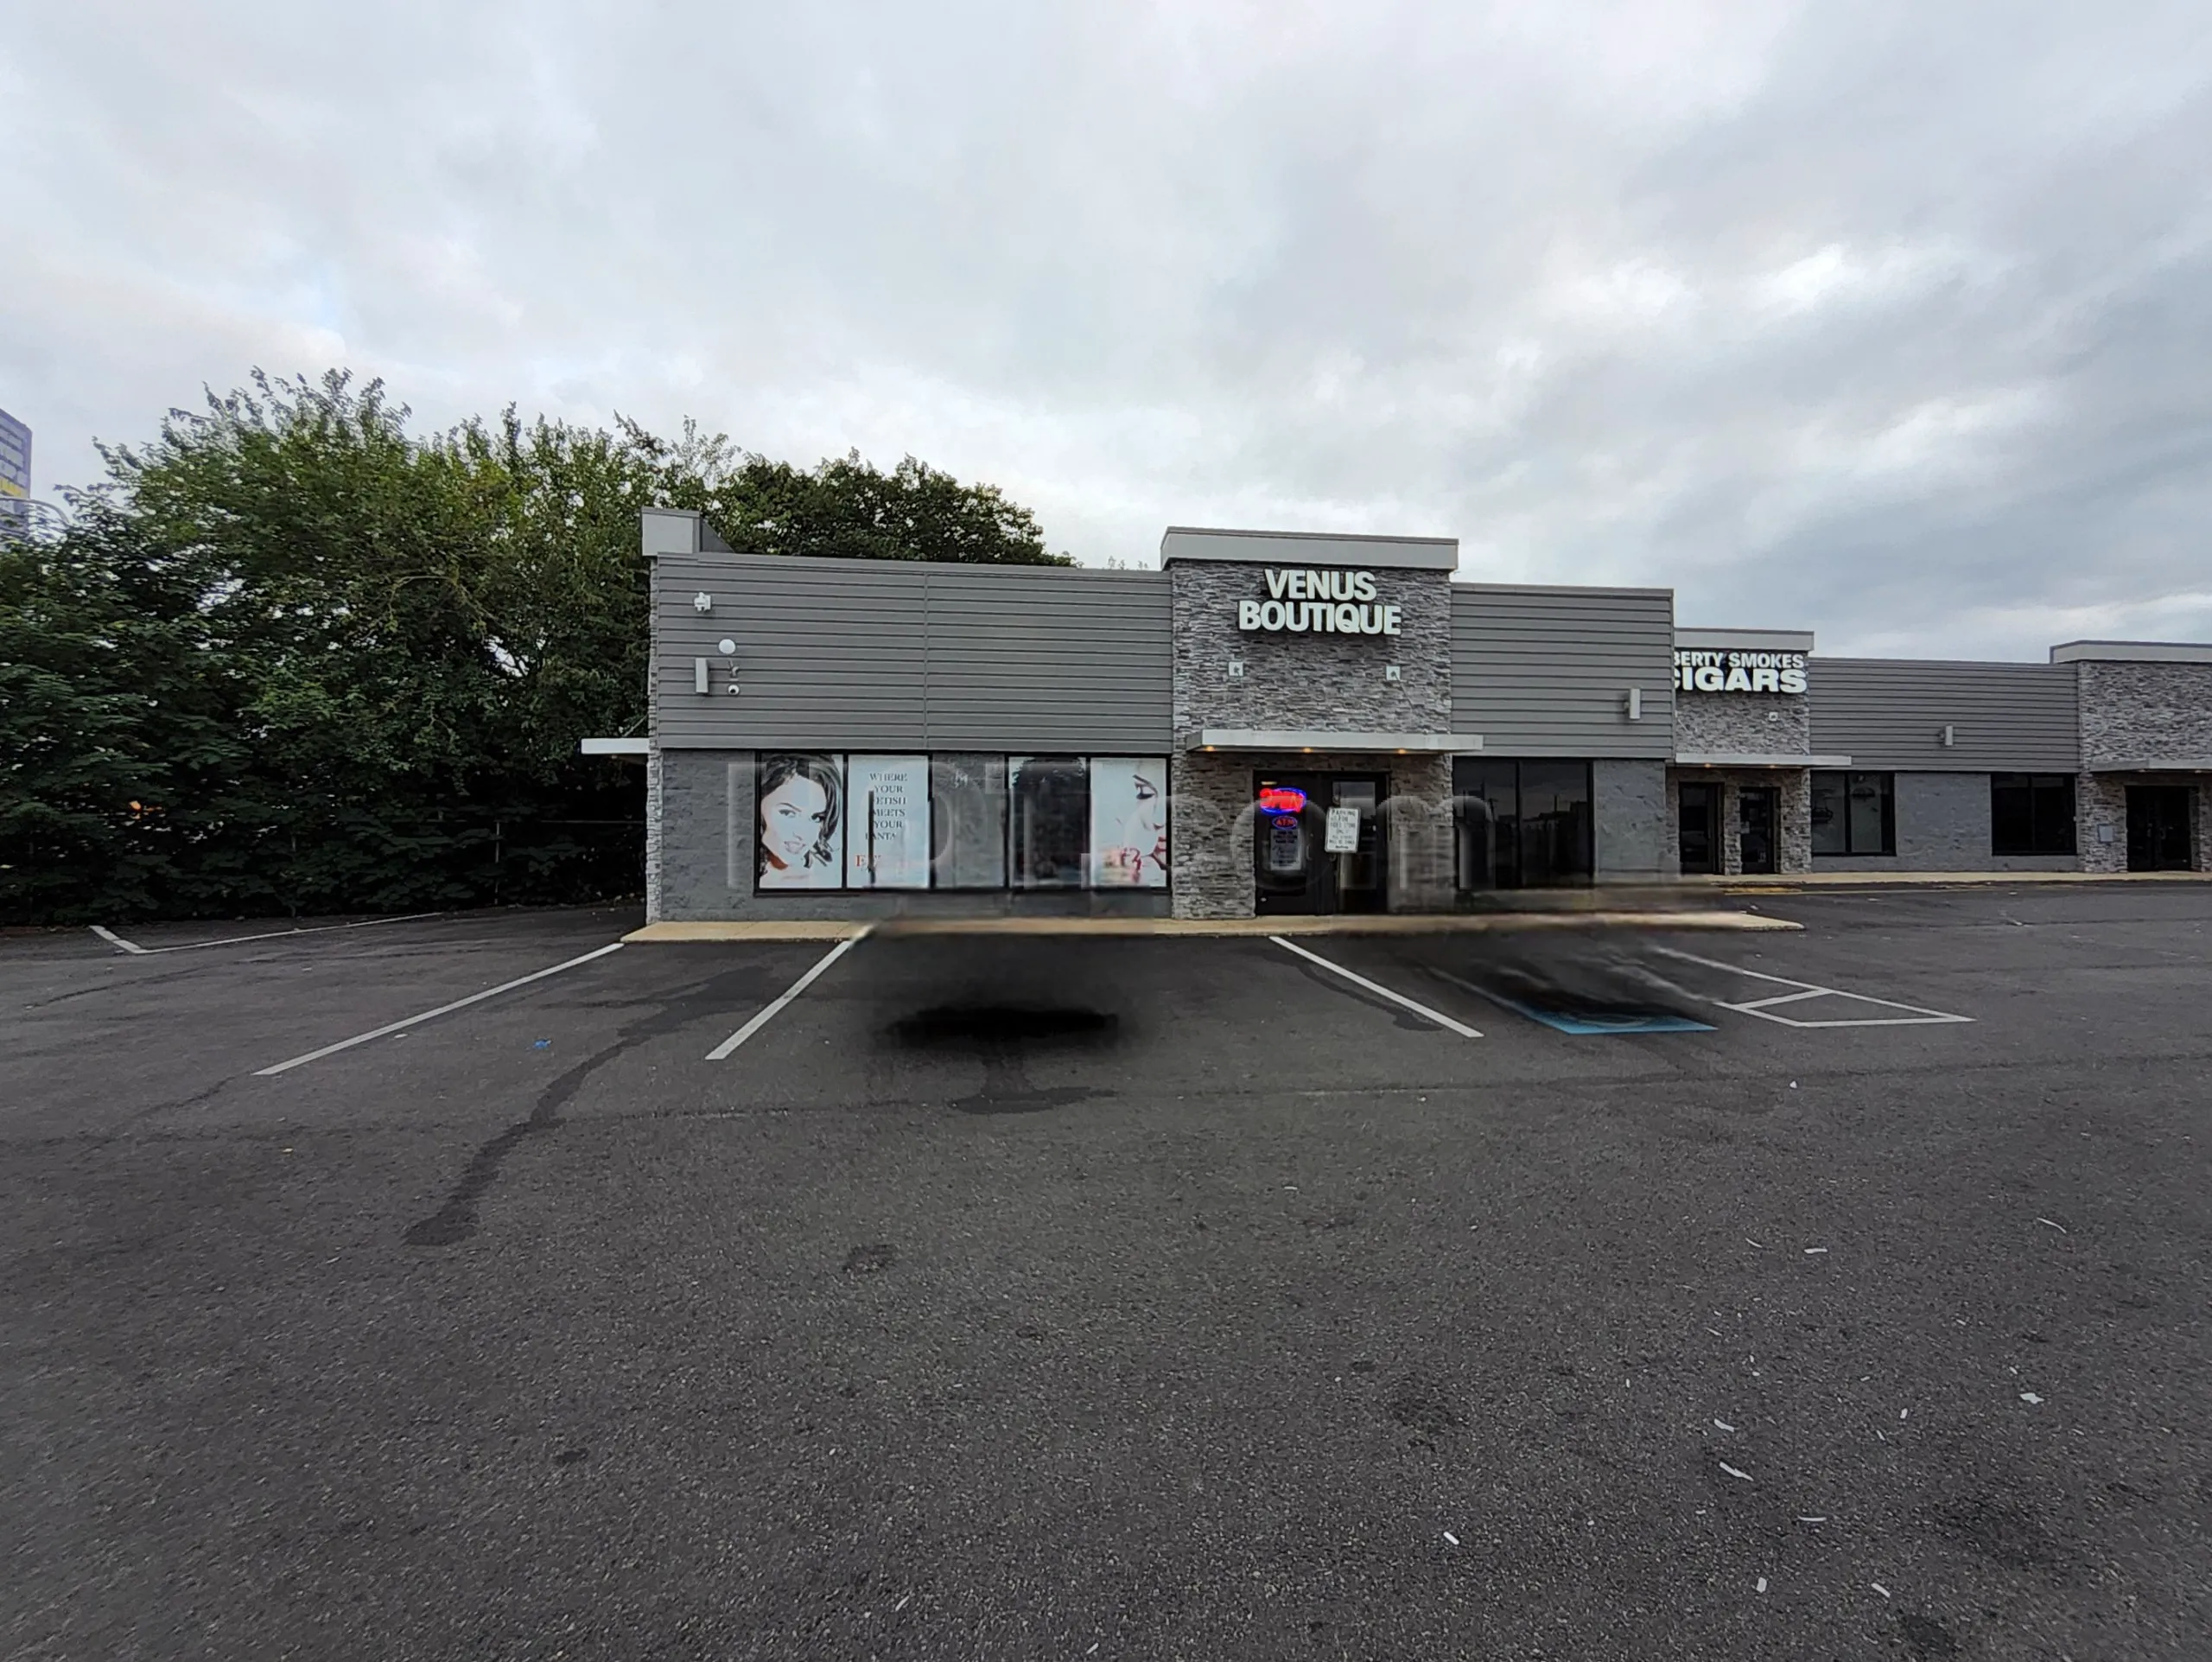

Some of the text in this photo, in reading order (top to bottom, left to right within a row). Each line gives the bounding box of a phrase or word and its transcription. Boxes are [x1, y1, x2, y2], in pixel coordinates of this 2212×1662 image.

[1263, 568, 1377, 602] VENUS
[1238, 600, 1402, 635] BOUTIQUE
[1728, 652, 1804, 668] SMOKES
[1674, 666, 1808, 693] IGARS
[869, 773, 908, 781] WHERE
[874, 785, 904, 794] YOUR
[873, 797, 906, 806] ETISH
[874, 819, 903, 829] YOUR
